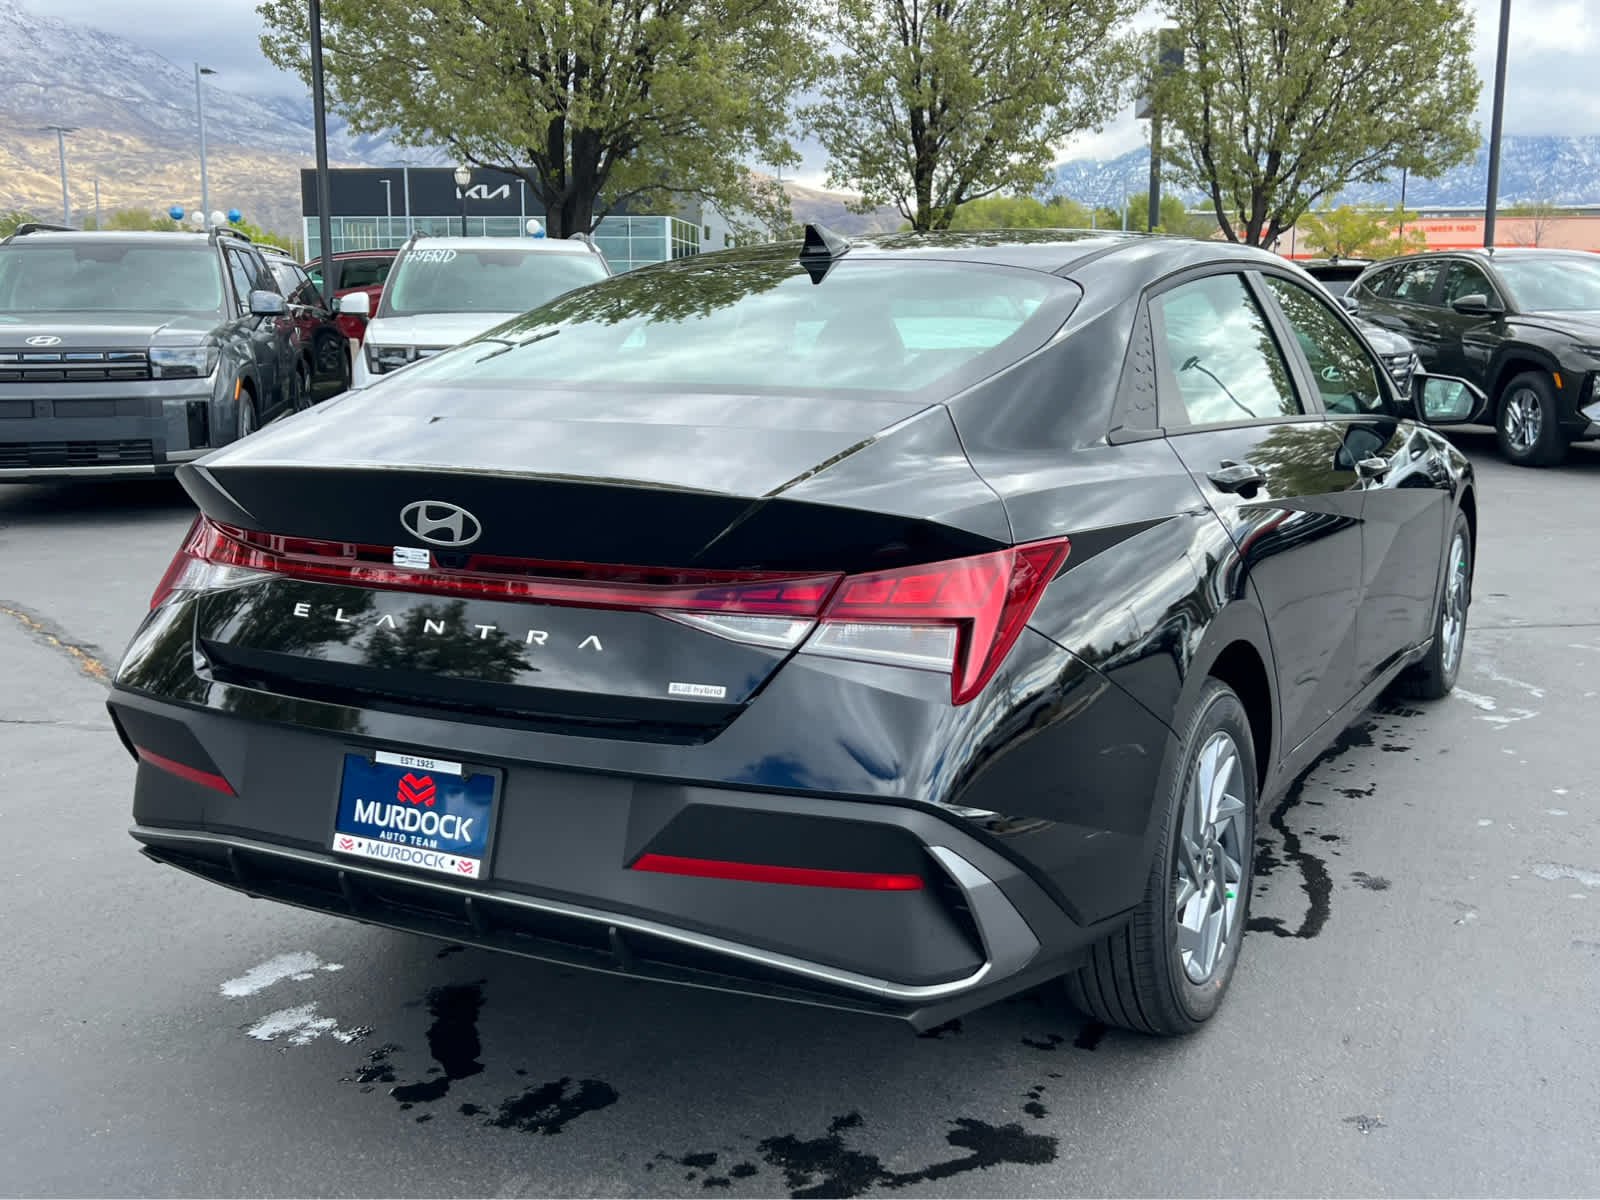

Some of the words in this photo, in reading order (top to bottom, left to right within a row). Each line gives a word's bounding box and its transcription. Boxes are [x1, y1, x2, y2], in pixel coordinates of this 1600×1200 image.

[405, 249, 457, 263] HYBRID
[293, 602, 603, 651] ELANTRA
[416, 759, 434, 769] 1925
[353, 798, 473, 843] MURDOCK
[379, 830, 406, 843] AUTO
[410, 835, 437, 849] TEAM
[365, 842, 446, 869] MURDOCK
